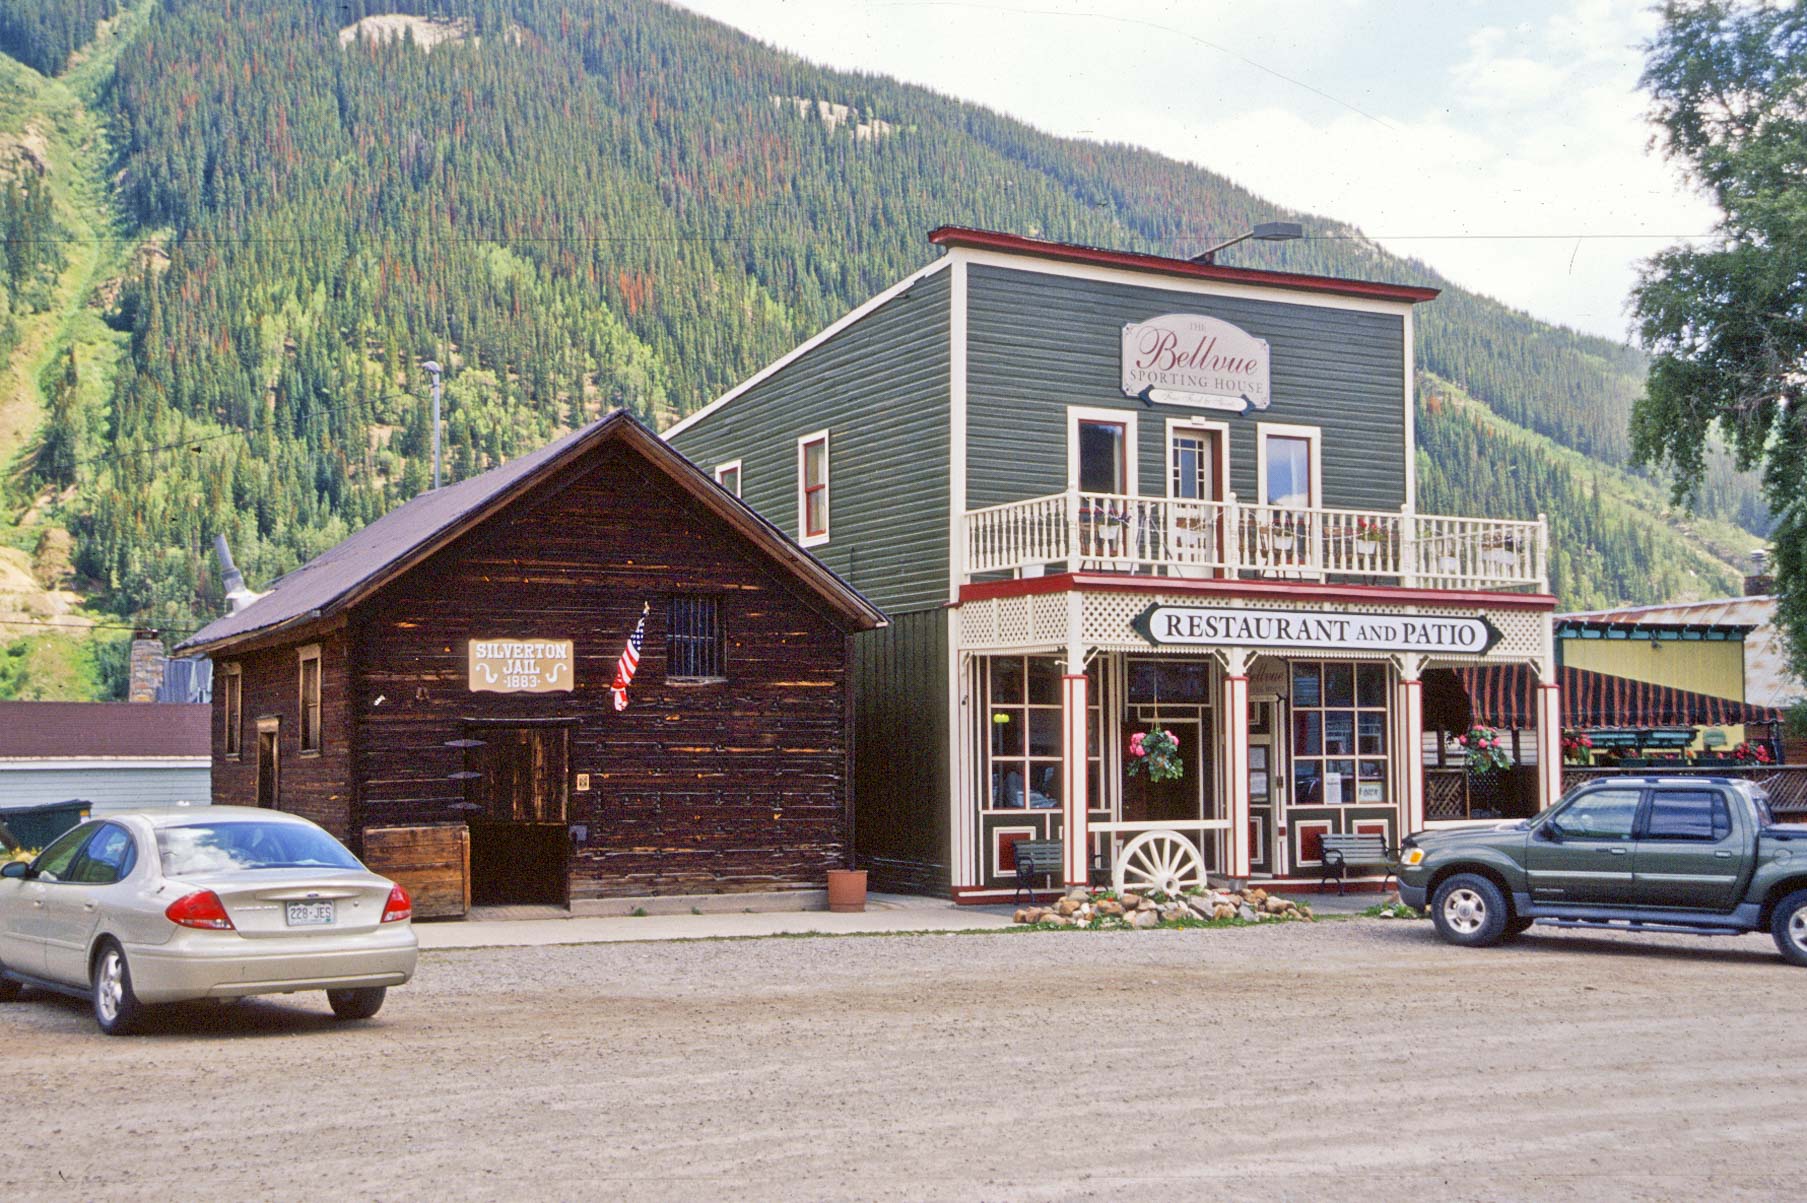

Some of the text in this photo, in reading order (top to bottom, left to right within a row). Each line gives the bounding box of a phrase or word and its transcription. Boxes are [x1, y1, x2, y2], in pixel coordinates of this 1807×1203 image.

[1189, 321, 1207, 332] THE
[1135, 326, 1257, 376] Bellvue
[1129, 368, 1264, 394] SPORTING HOUSE
[1164, 613, 1477, 647] RESTAURANT AND PATIO
[476, 643, 568, 659] SILVERTON
[503, 659, 540, 675] JAIL
